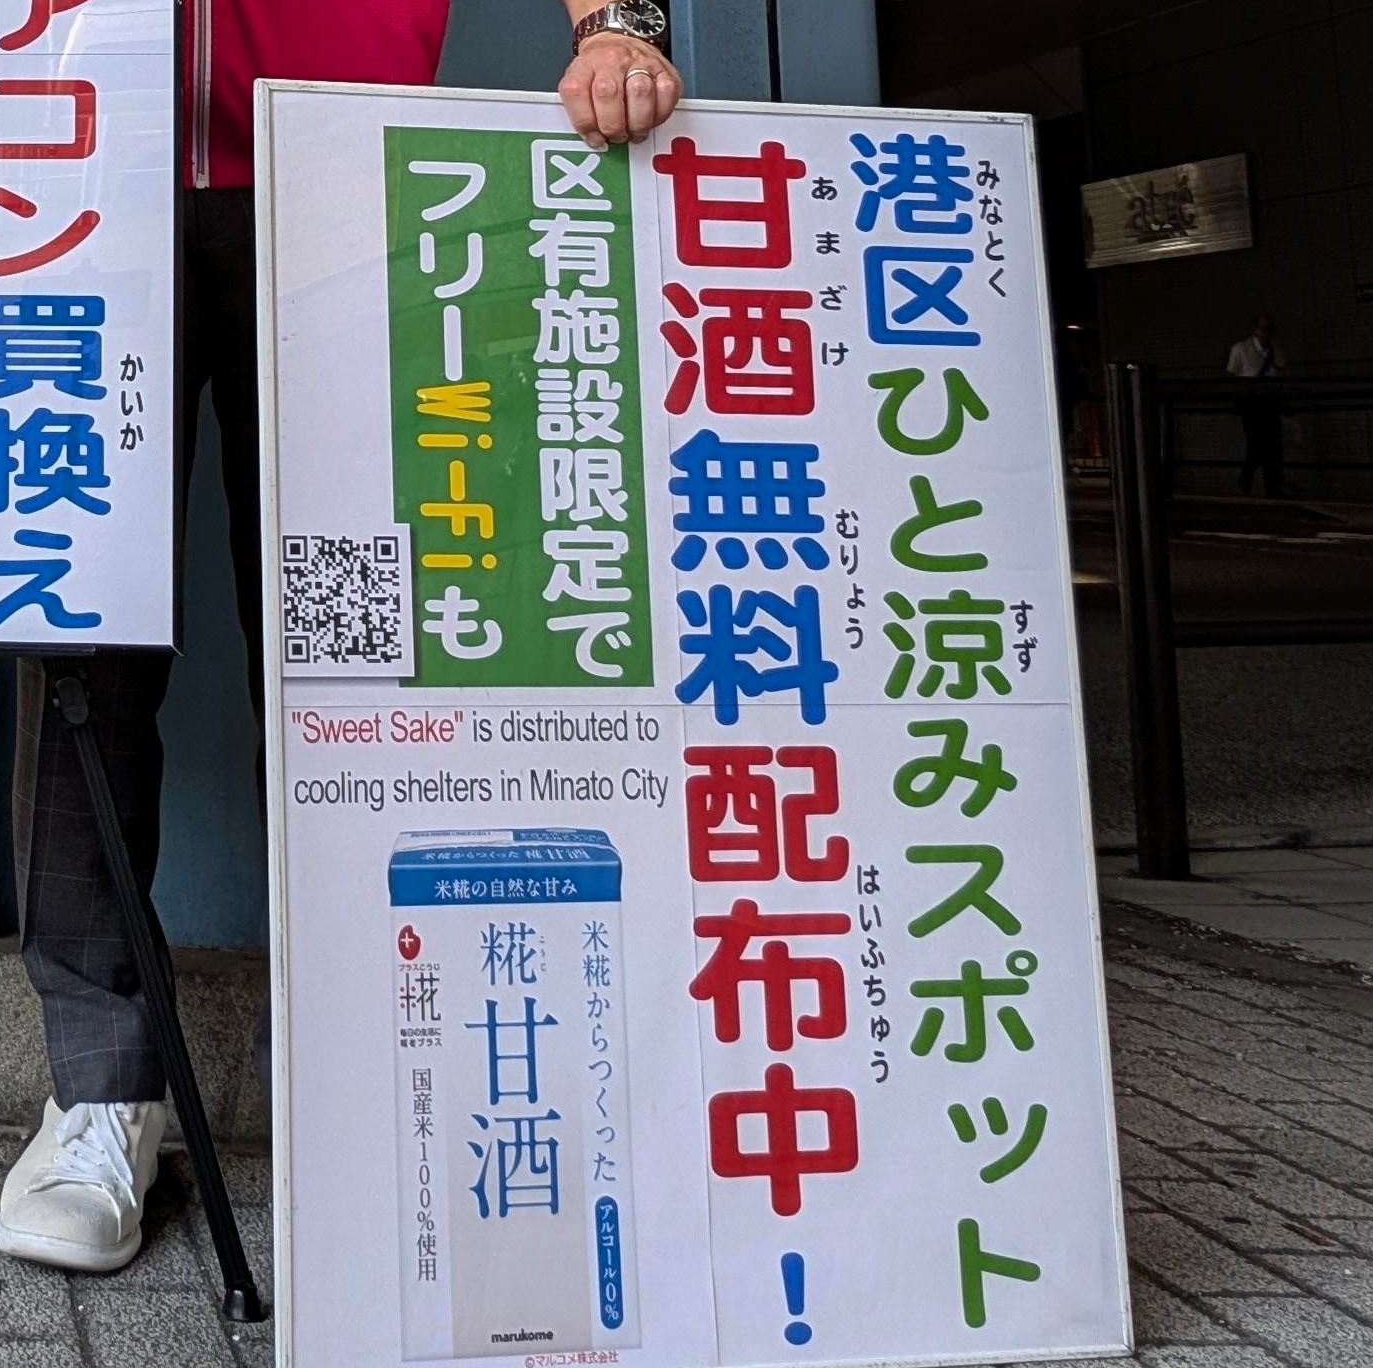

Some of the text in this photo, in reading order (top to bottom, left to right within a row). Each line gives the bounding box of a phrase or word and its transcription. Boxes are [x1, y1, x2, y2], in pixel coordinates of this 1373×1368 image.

[810, 175, 849, 367] あまざけ
[975, 159, 1007, 297] みなとく
[119, 354, 145, 452] かいか
[528, 138, 633, 679] 区有施設限定で
[834, 508, 866, 649] むりょう
[1009, 599, 1037, 673] すず
[293, 768, 669, 812] cooling shelters in Minato City
[472, 711, 493, 743] is
[500, 710, 628, 742] distributed
[636, 712, 660, 742] to
[652, 136, 860, 1346] 甘酒無料配布中！
[848, 133, 1048, 1328] 港区ひと涼みスポット
[433, 877, 578, 899] 米糀の自然な甘み
[856, 863, 892, 1084] はいふちゅう
[464, 922, 561, 1219] 糀甘酒
[582, 920, 616, 1182] 米糀からつくった
[491, 1328, 554, 1344] marukome
